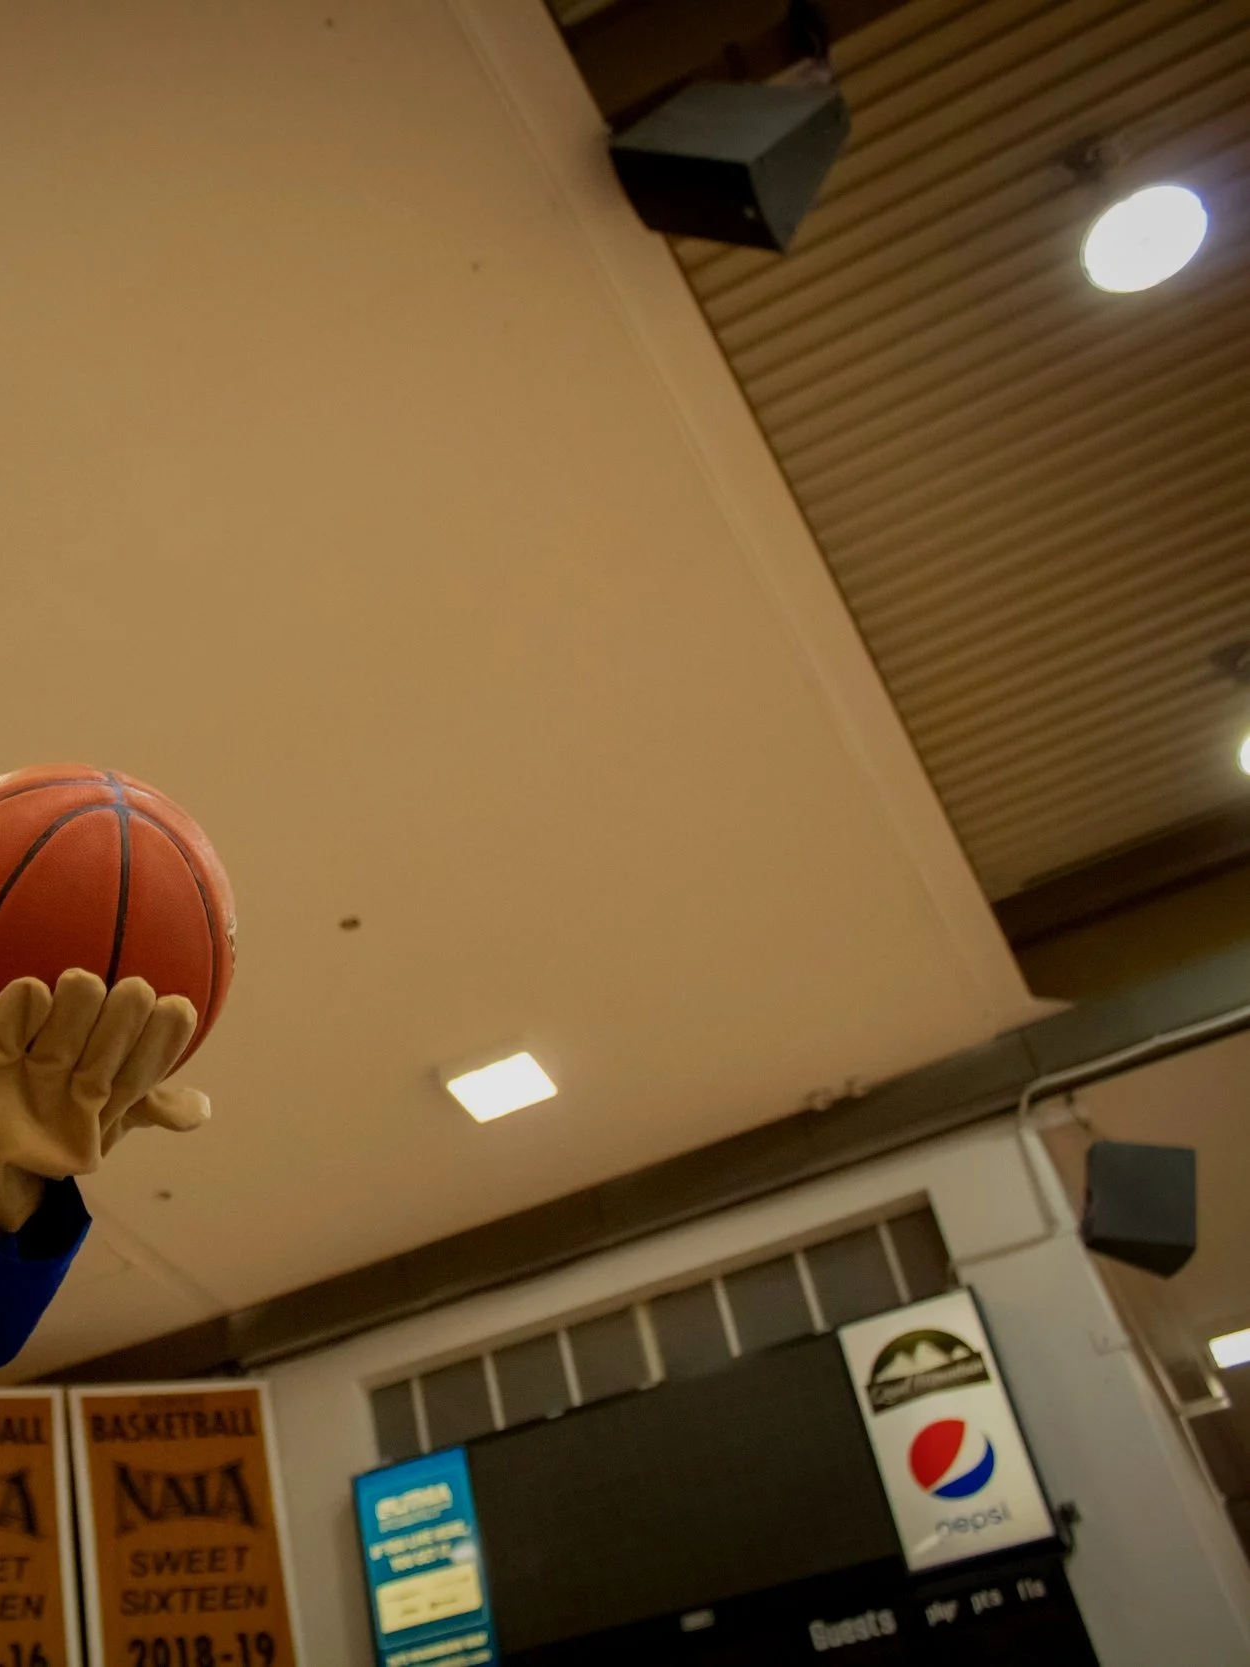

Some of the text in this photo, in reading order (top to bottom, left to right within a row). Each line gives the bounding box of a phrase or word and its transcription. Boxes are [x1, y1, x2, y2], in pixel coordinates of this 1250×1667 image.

[90, 1408, 258, 1444] BASKETBALL
[114, 1459, 260, 1533] NAIA
[129, 1546, 250, 1577] SWEET
[119, 1585, 268, 1616] SIXTEEN
[807, 1607, 899, 1652] Guests
[128, 1631, 276, 1667] 2018-19
